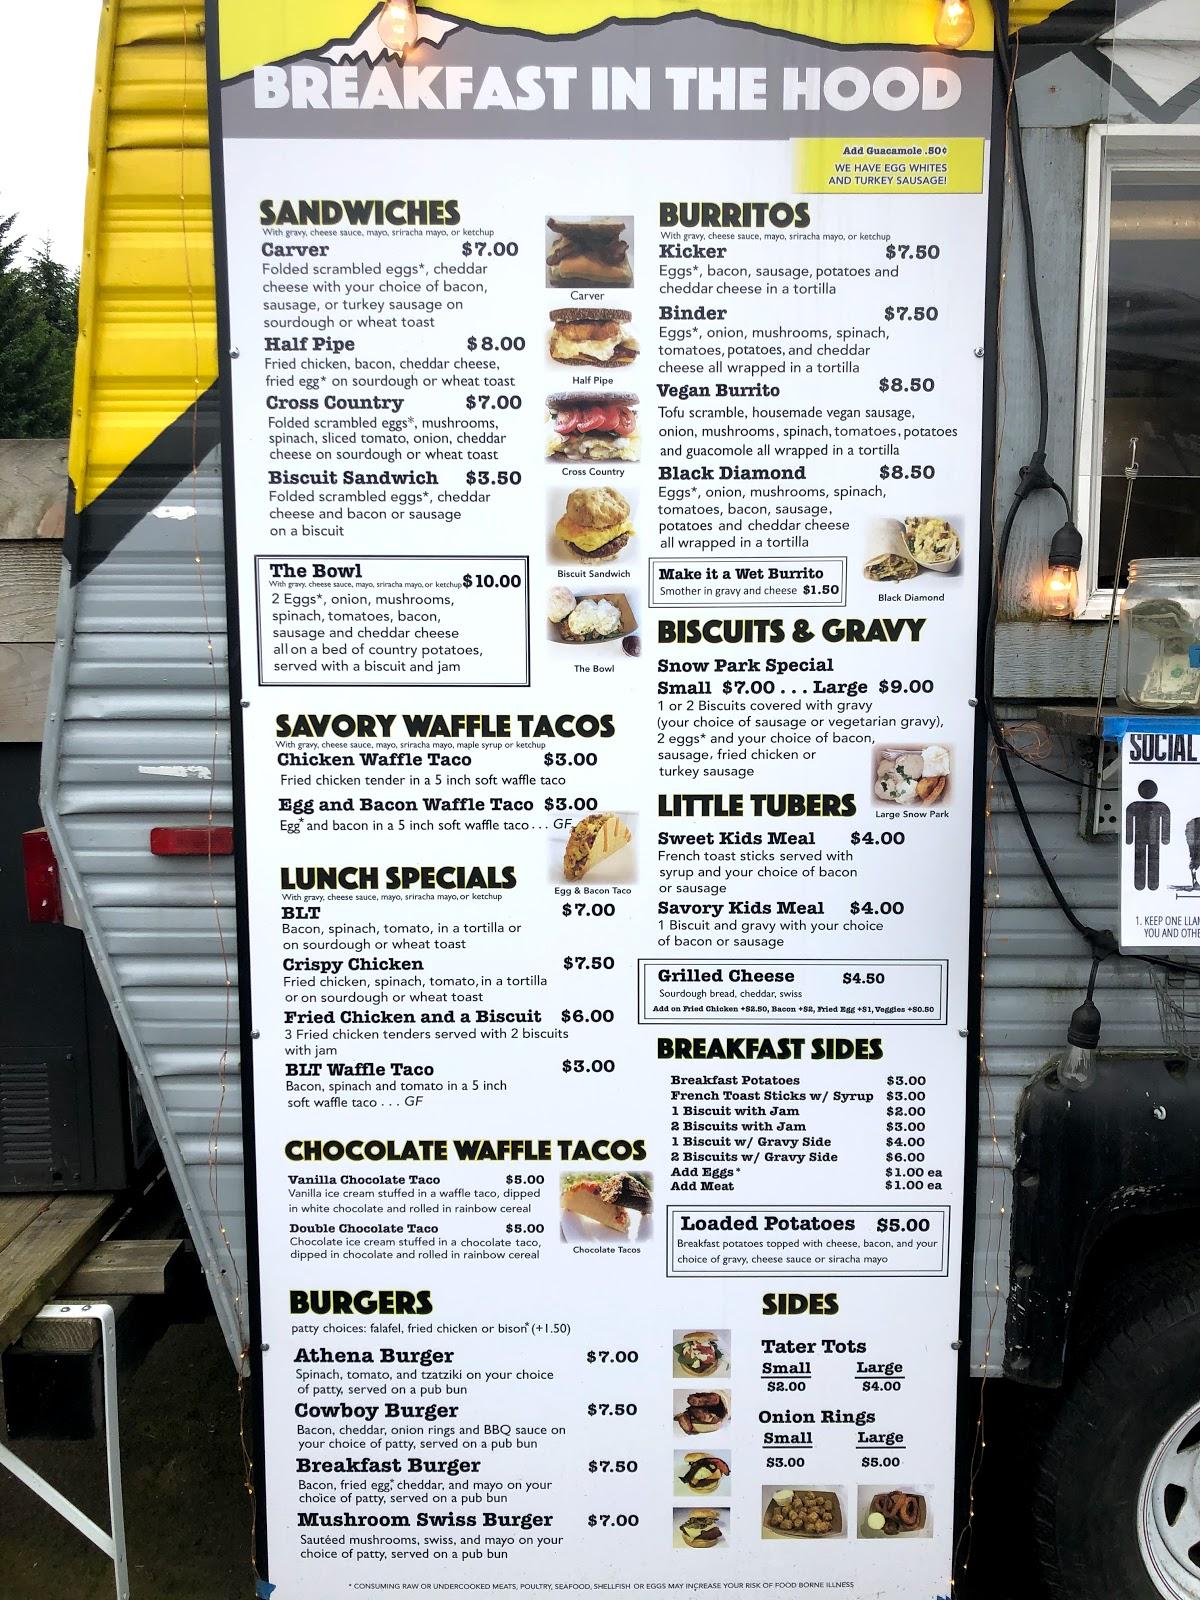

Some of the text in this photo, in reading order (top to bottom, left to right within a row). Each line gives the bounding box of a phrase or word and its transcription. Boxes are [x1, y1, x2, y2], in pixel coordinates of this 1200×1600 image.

[254, 67, 961, 111] BREAKFAST IN THE HOOD
[843, 147, 864, 155] Add
[867, 147, 922, 155] Guacamole
[835, 164, 947, 172] WE HAVE EGG WHITES
[829, 176, 946, 184] AND TURKEY SAUSAGE!
[260, 200, 460, 225] SANDWICHES
[660, 202, 810, 228] BURRITOS
[263, 228, 283, 236] With
[286, 230, 307, 238] gravy,
[310, 228, 337, 236] cheese
[367, 230, 389, 238] mayo,
[392, 228, 423, 236] sriracha
[463, 228, 494, 238] ketchup
[262, 242, 329, 257] Carver
[659, 243, 727, 258] Kicker
[263, 263, 308, 274] Folded
[313, 262, 381, 274] scrambled
[434, 262, 487, 274] cheddar
[571, 291, 604, 300] Carver
[659, 305, 727, 320] Binder
[885, 306, 938, 321] $7.50
[264, 336, 355, 354] Half Pipe
[573, 376, 613, 387] Half Pipe
[266, 396, 404, 413] Cross Country
[268, 470, 521, 486] Biscuit Sandwich $3.50
[589, 468, 624, 477] Country
[661, 585, 839, 597] Smother in gravy and cheese $1.50
[905, 593, 944, 601] Diamond
[274, 660, 317, 671] served
[321, 660, 348, 671] with
[365, 660, 406, 671] biscuit
[410, 661, 433, 672] and
[437, 661, 460, 674] jam
[658, 658, 834, 674] Snow Park Special
[276, 714, 615, 738] SAVORY WAFFLE TACOS
[1130, 733, 1197, 761] SOCIAL
[659, 794, 856, 817] LITTLE TUBERS
[876, 811, 900, 819] Large
[281, 866, 516, 890] LUNCH SPECIALS
[555, 887, 571, 896] Egg
[281, 907, 320, 919] BLT
[1136, 916, 1142, 926] 1.
[1145, 916, 1163, 926] KEEP
[1165, 916, 1182, 926] ONE
[1144, 928, 1160, 938] YOU
[1162, 928, 1179, 938] AND
[658, 968, 794, 982] Grilled Cheese
[843, 972, 885, 984] $4.50
[660, 989, 706, 999] Sourdough
[710, 989, 737, 998] bread,
[740, 990, 776, 998] cheddar,
[658, 1038, 883, 1060] BREAKFAST SIDES
[672, 1106, 800, 1116] 1 Biscuit with Jam
[887, 1106, 925, 1116] $2.00
[285, 1140, 646, 1161] CHOCOLATE WAFFLE TACOS
[681, 1216, 930, 1233] Loaded Potatoes $5.00
[291, 1250, 327, 1261] dipped
[331, 1250, 339, 1258] in
[343, 1250, 393, 1258] chocolate
[396, 1250, 415, 1258] and
[419, 1250, 447, 1259] rolled
[464, 1250, 505, 1259] rainbow
[509, 1250, 539, 1259] cereal
[290, 1290, 433, 1315] BURGERS
[763, 1293, 839, 1315] SIDES
[762, 1340, 866, 1353] Tater Tots
[294, 1348, 454, 1366] Athena Burger
[768, 1381, 806, 1392] $2.00
[295, 1403, 459, 1421] Cowboy Burger
[759, 1410, 875, 1426] Onion Rings
